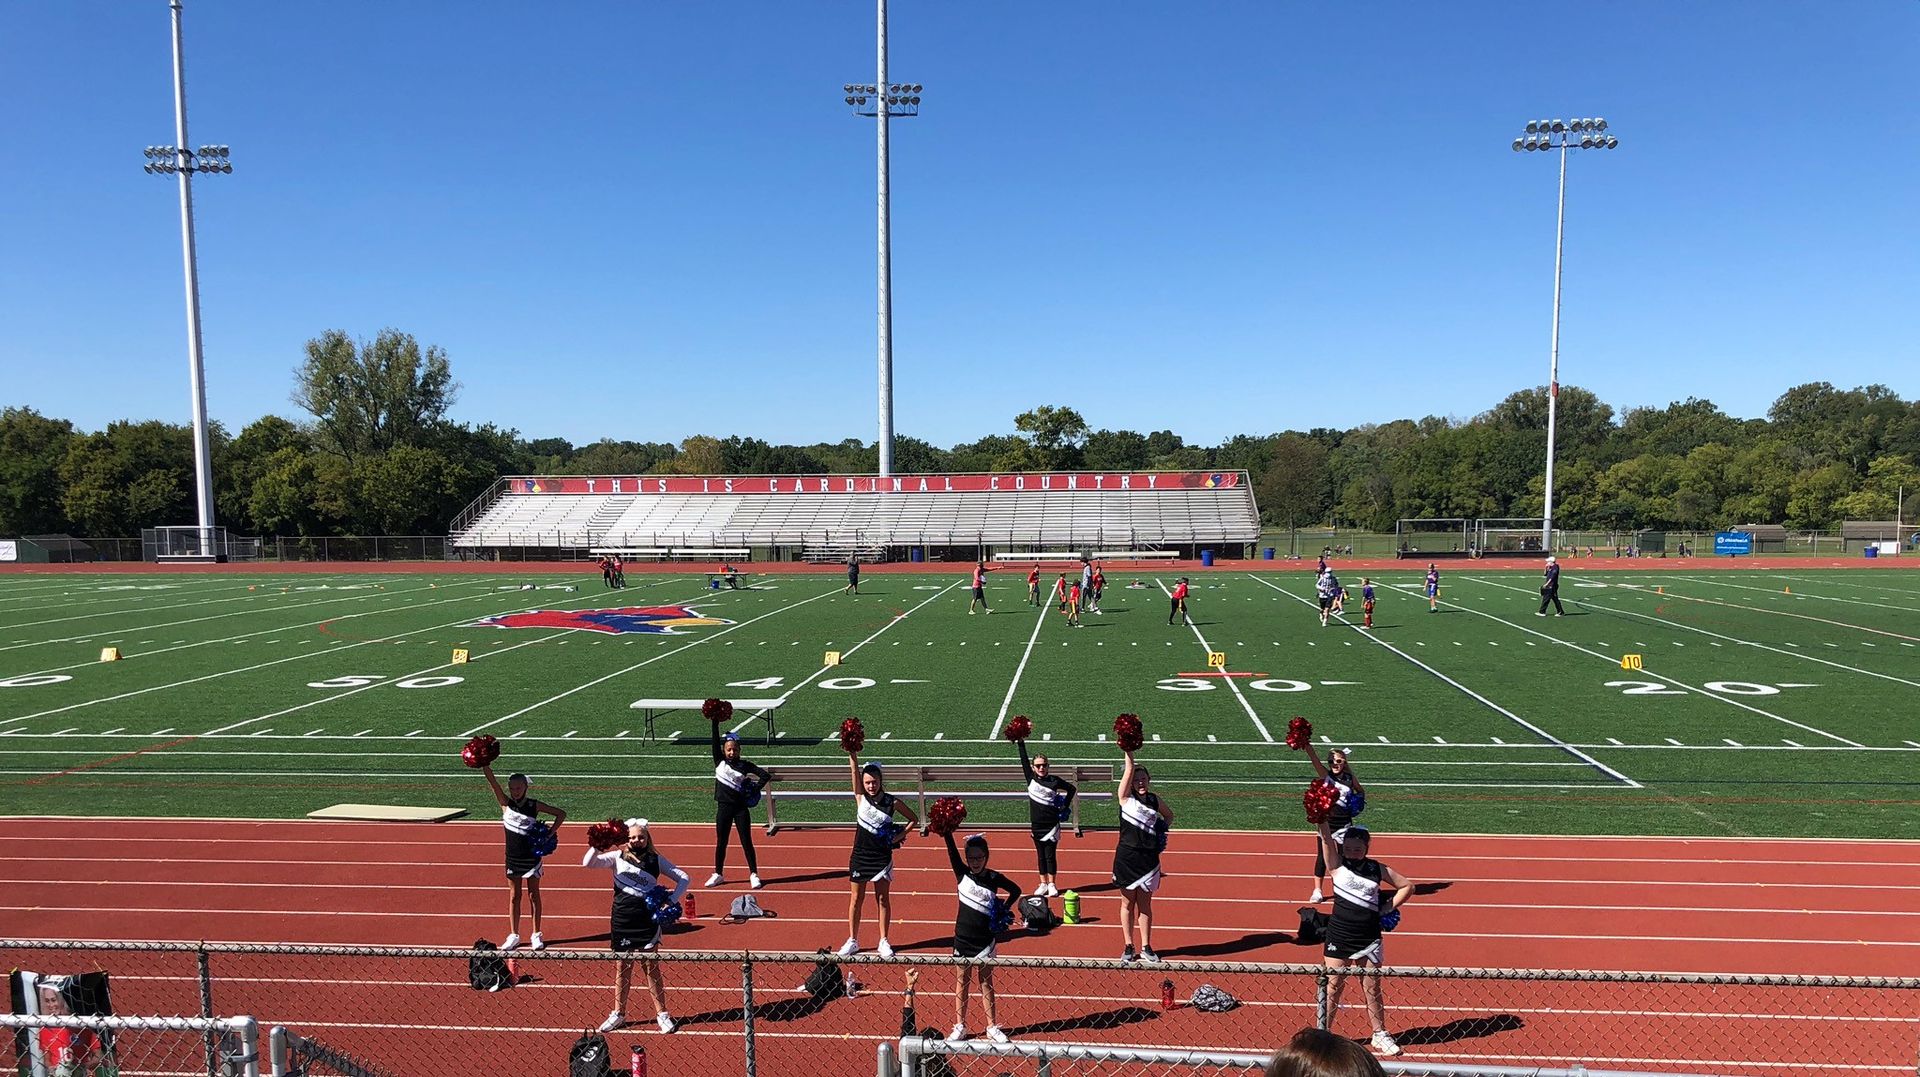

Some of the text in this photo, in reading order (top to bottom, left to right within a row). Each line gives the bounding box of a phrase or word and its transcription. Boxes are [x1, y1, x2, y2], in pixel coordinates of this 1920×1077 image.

[587, 475, 1157, 492] THIS IS CARDINAL COUNTRY
[1210, 653, 1224, 666] 20
[1627, 656, 1641, 669] 10
